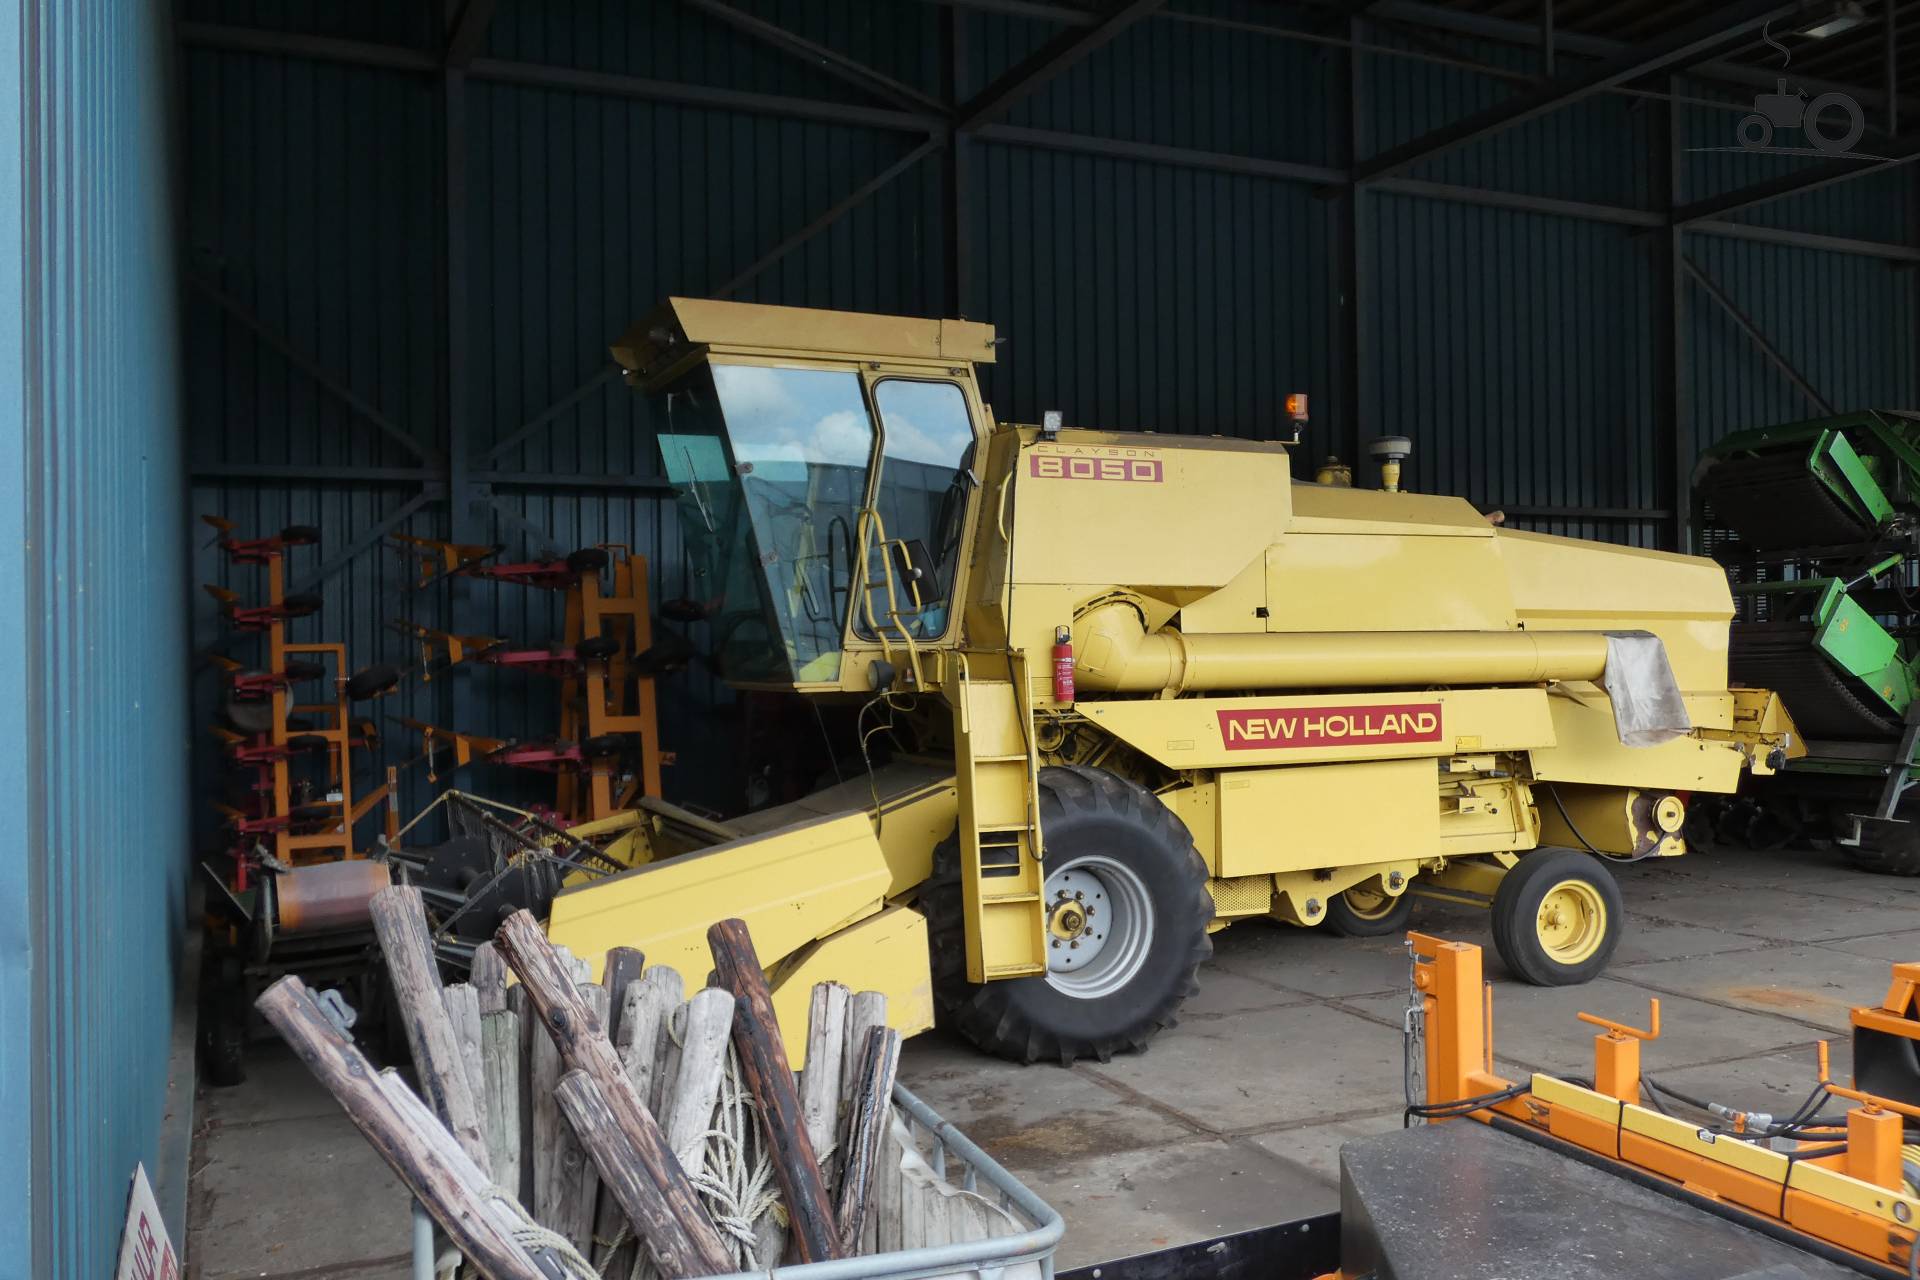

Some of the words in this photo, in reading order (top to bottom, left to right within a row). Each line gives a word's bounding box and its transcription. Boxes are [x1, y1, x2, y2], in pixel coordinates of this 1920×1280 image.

[1037, 445, 1154, 457] CLAYSON
[1038, 457, 1155, 481] 8050
[1229, 717, 1297, 740] NEW
[1304, 712, 1437, 738] HOLLAND
